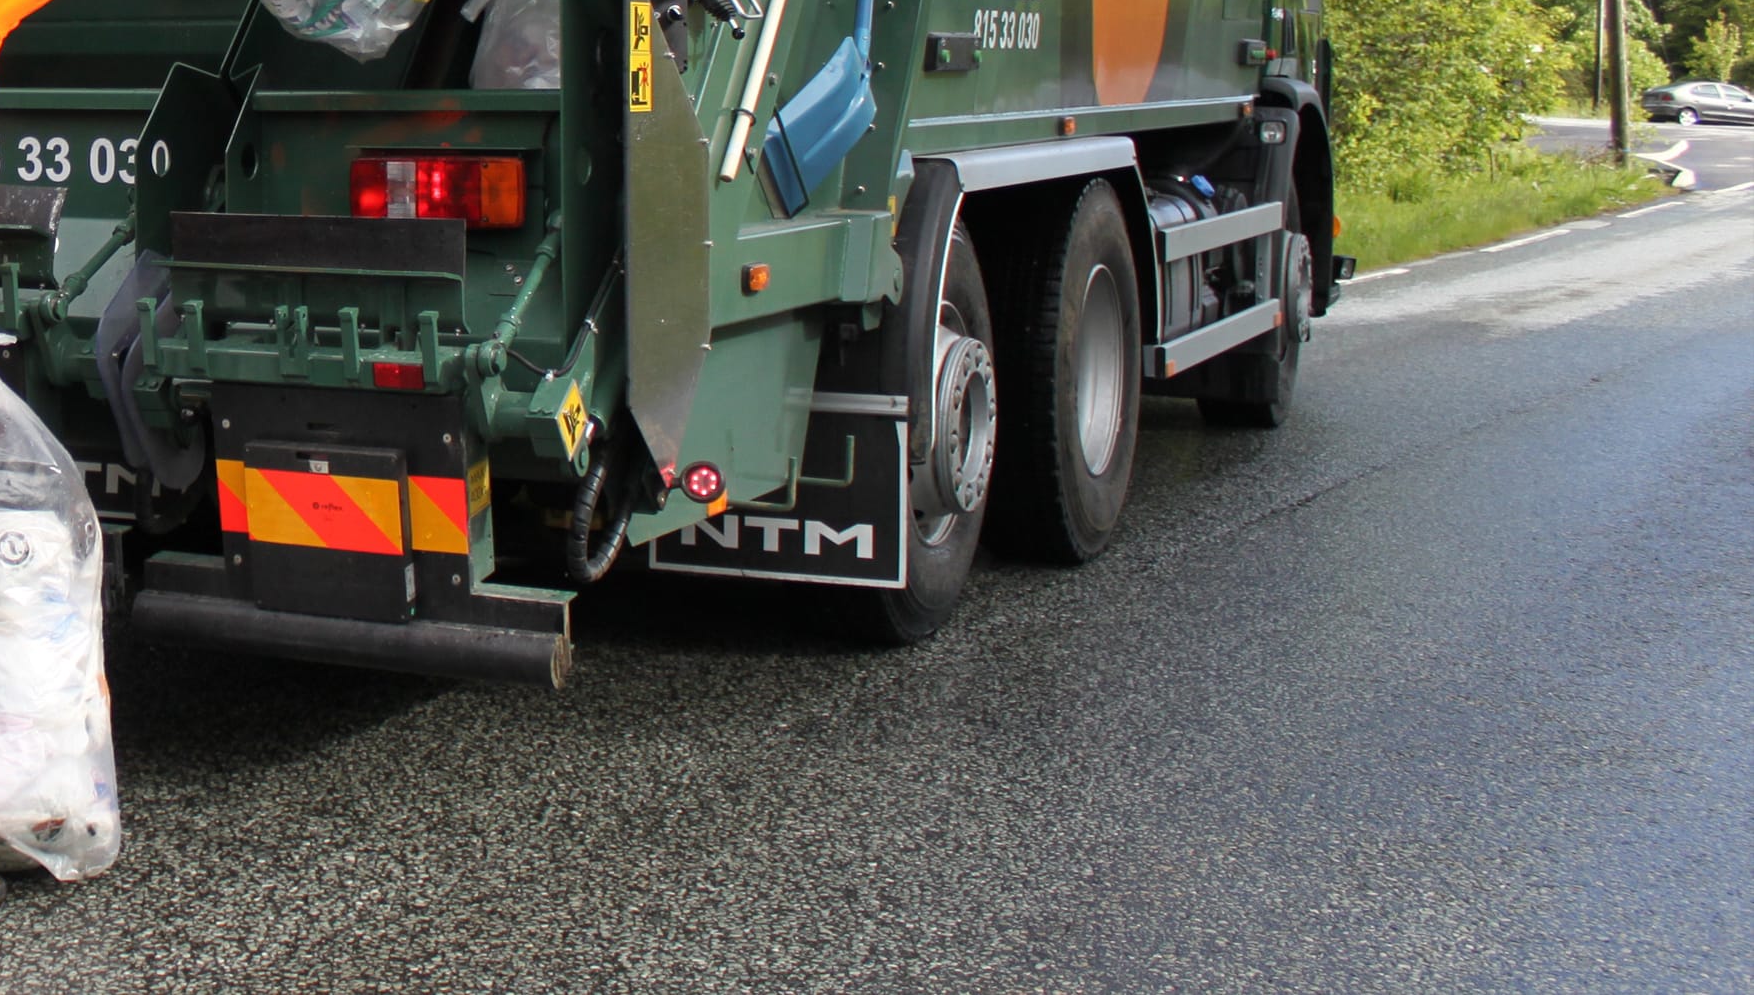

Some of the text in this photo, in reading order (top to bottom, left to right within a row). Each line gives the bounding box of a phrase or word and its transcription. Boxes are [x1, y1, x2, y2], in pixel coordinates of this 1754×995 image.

[973, 9, 1040, 49] 815 33 030
[17, 136, 71, 183] 33
[89, 137, 171, 185] 030
[680, 514, 874, 559] NTM
